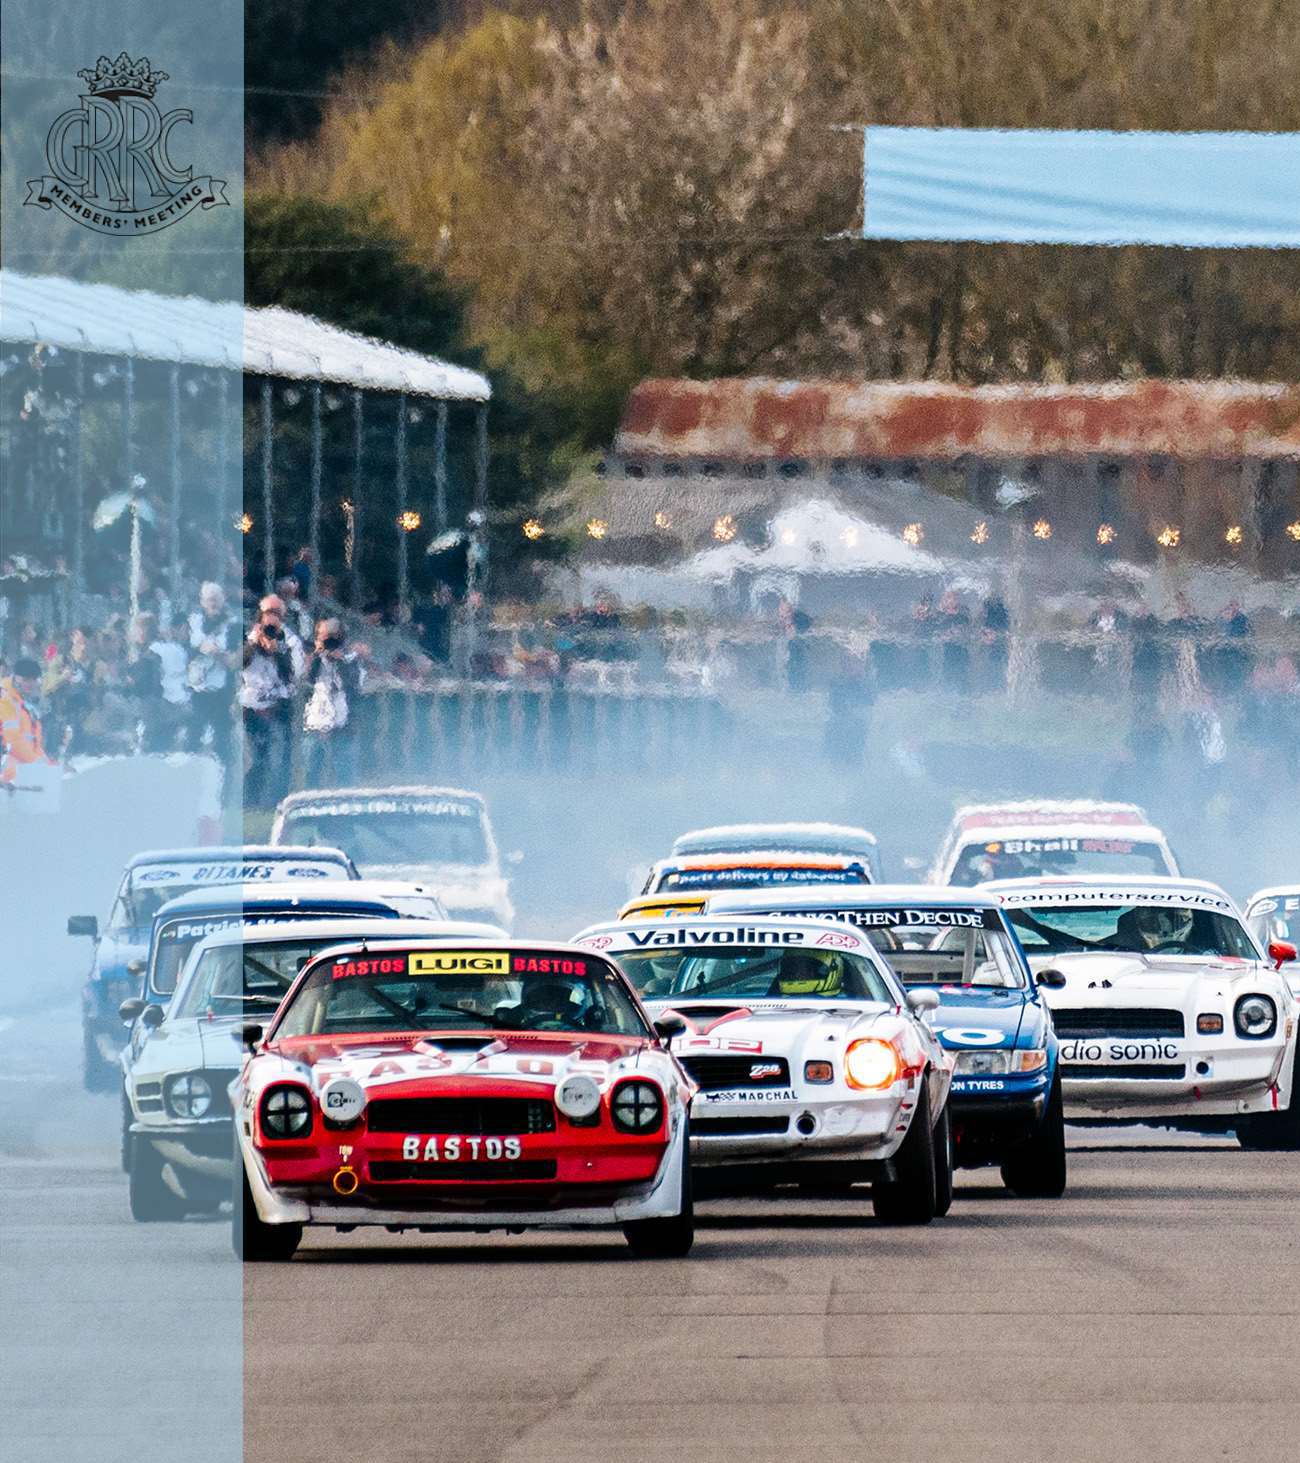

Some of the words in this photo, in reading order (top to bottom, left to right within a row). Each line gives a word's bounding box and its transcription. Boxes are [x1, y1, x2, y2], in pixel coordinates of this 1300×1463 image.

[1008, 891, 1230, 910] computerservice
[904, 910, 984, 928] DECIDE
[627, 927, 804, 946] Valvoline
[332, 958, 405, 979] BASTOS
[415, 958, 503, 970] LUIGI
[513, 957, 587, 976] BASTOS
[1061, 1039, 1102, 1060] dio
[1110, 1038, 1178, 1060] sonic
[951, 1082, 966, 1090] ON
[967, 1081, 1004, 1090] TYRES
[738, 1090, 799, 1101] MARCHAL
[402, 1136, 521, 1161] BASTOS
